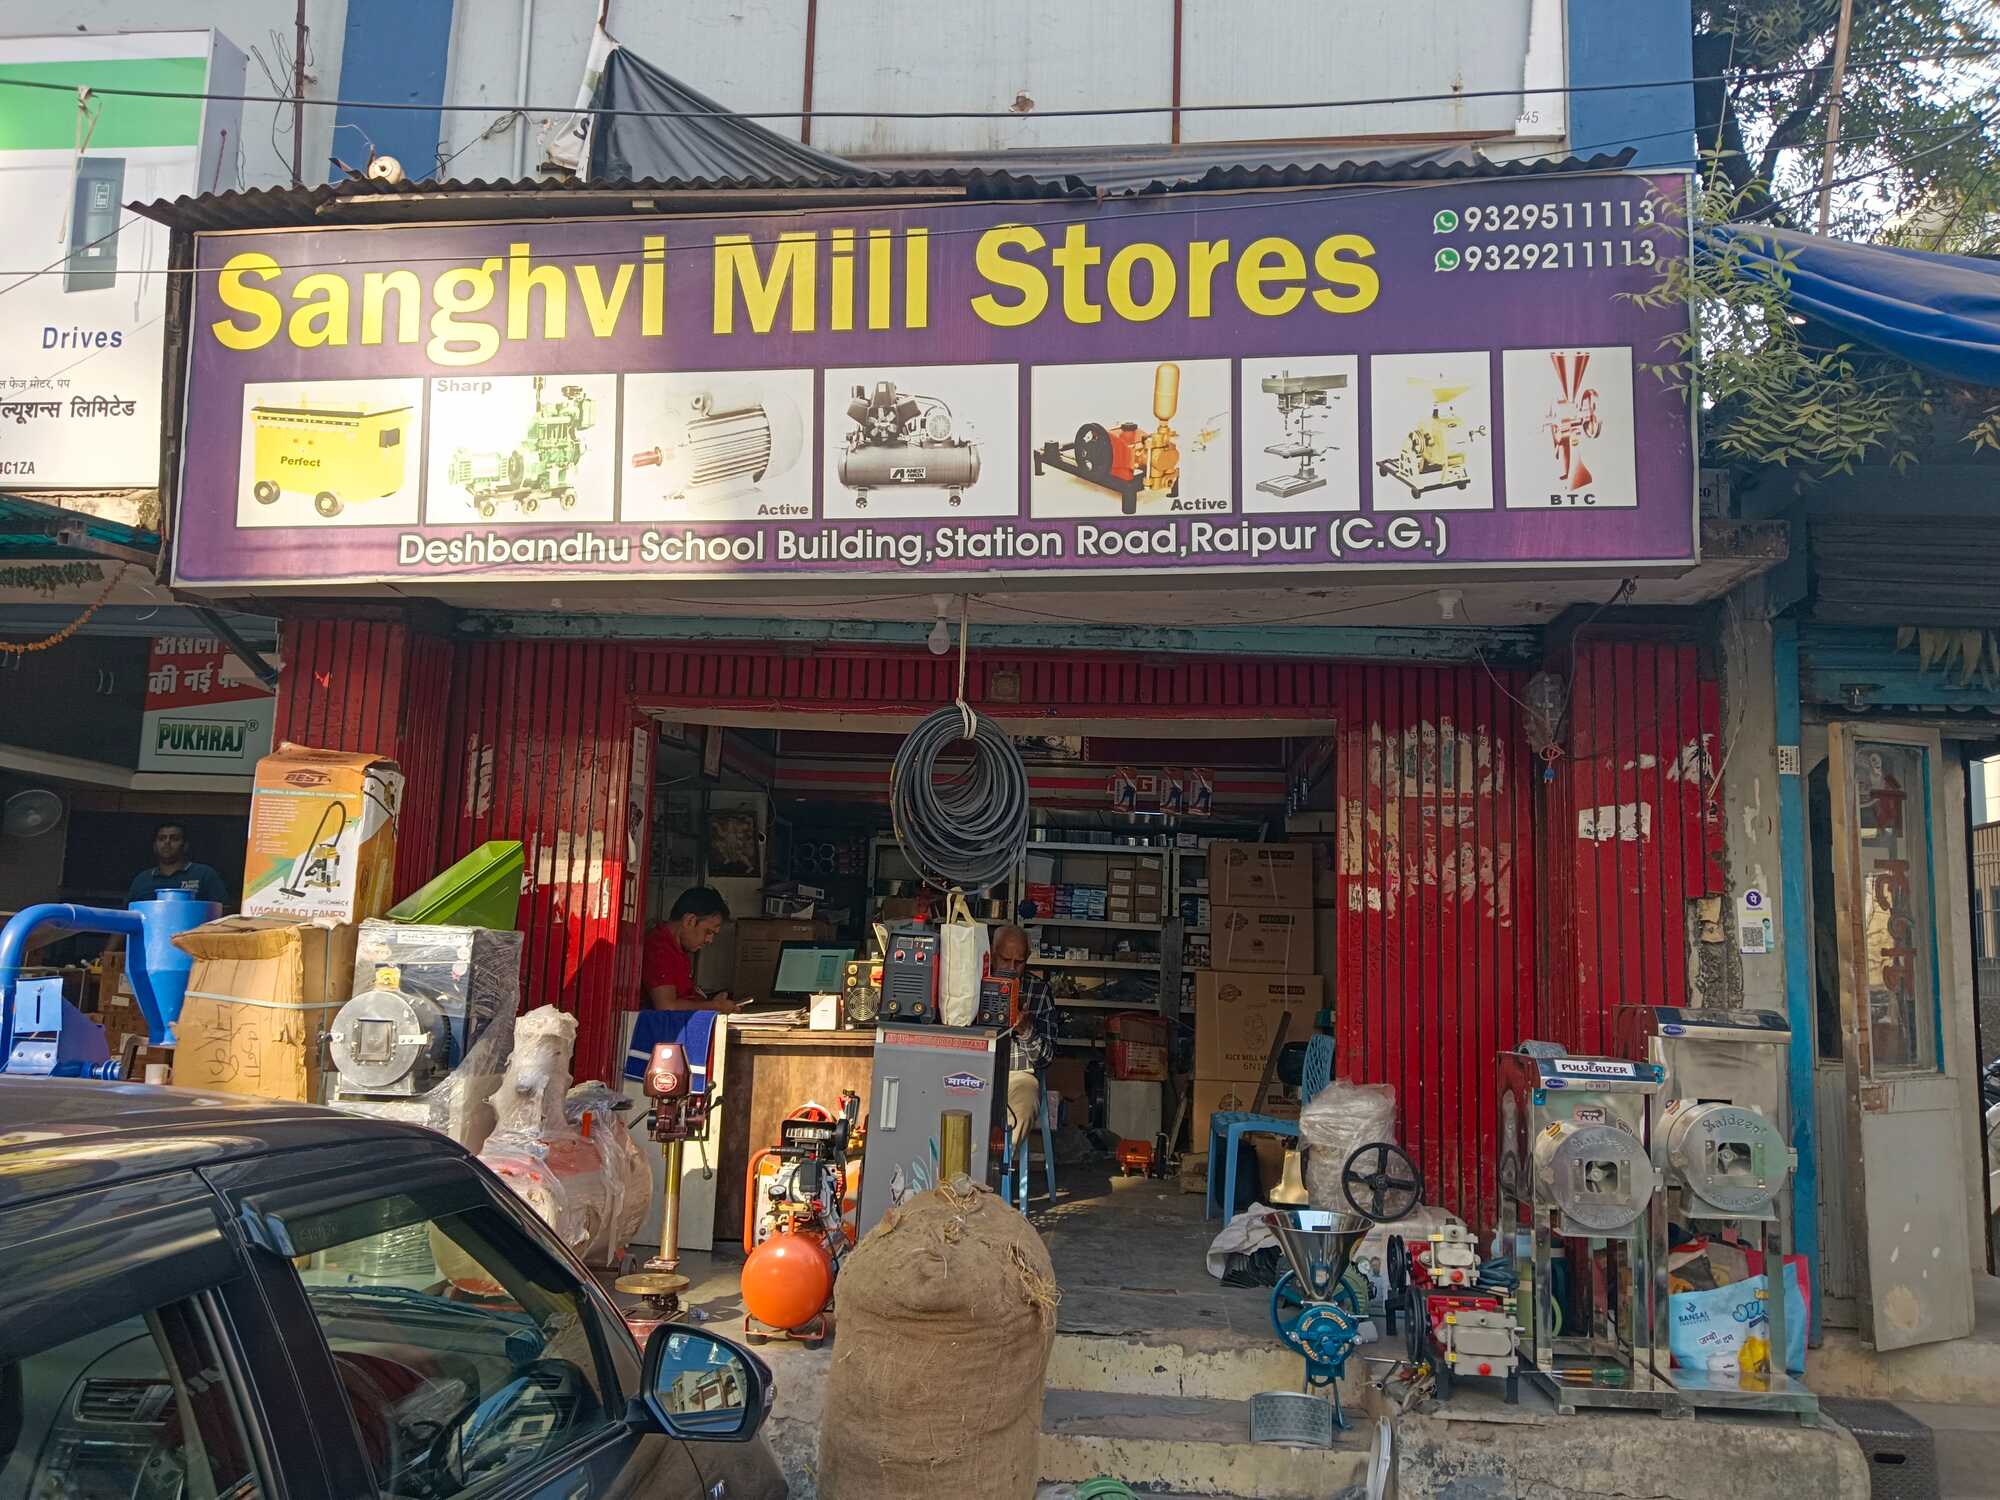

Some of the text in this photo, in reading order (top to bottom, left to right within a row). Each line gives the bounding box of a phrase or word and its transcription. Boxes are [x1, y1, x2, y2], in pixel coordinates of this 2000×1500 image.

[1464, 200, 1655, 232] 9329511113
[1464, 239, 1656, 271] 9329211113
[211, 222, 1380, 367] Sanghvi Mill Stores
[42, 327, 123, 349] Drives
[436, 379, 493, 395] Sharp
[70, 395, 137, 418] लिमिटेड
[280, 456, 321, 467] Perfect
[757, 504, 809, 516] Active
[1170, 498, 1228, 511] Active
[399, 532, 630, 565] Deshbandhu
[640, 530, 765, 562] School
[1329, 516, 1448, 558] (C.G.)
[157, 723, 244, 753] PUKHRAJ
